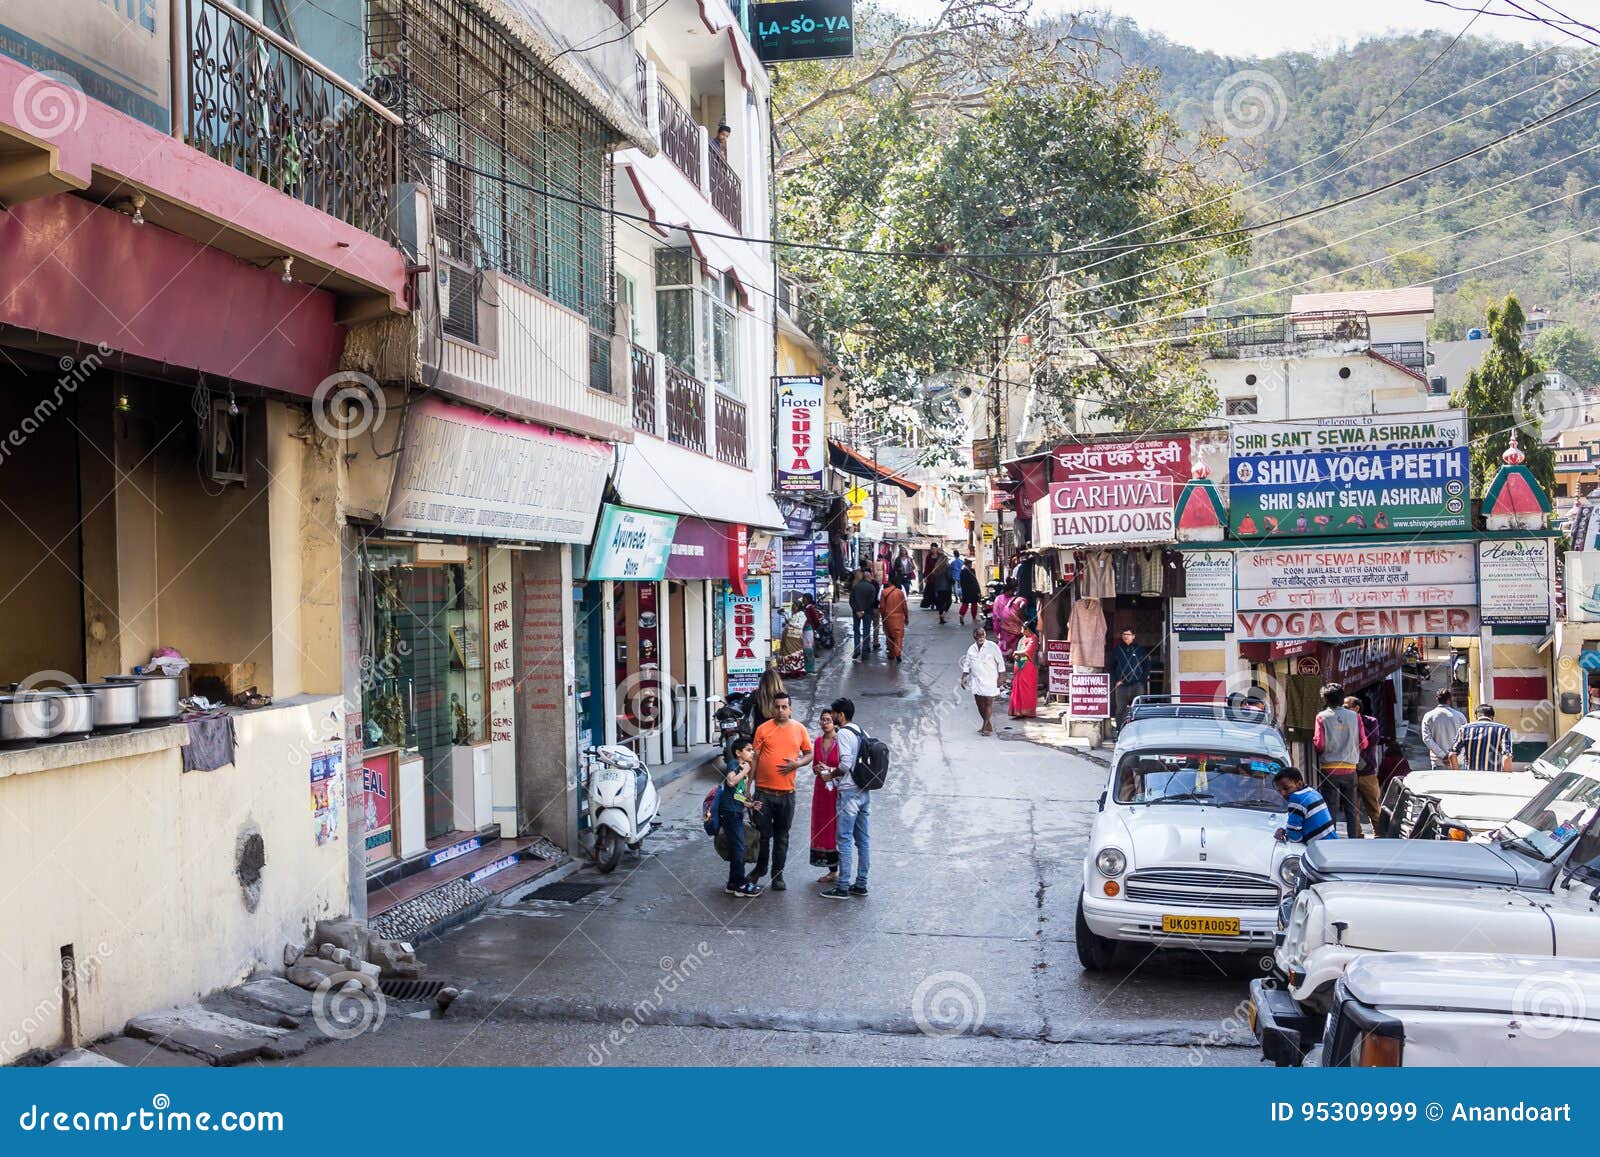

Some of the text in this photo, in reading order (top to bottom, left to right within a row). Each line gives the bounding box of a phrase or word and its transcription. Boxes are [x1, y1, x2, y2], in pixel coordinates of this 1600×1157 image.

[782, 398, 821, 408] Hotel
[791, 408, 811, 470] SURYA
[1236, 434, 1267, 449] SHRI
[1272, 431, 1311, 447] SANT
[1318, 428, 1365, 445] SEWA
[1370, 424, 1436, 442] ASHRAM
[1060, 447, 1103, 469] दर्शन
[1105, 450, 1134, 466] एक
[1137, 441, 1182, 469] मुखी
[1257, 452, 1461, 484] SHIVA YOGA PEETH
[1054, 481, 1169, 510] GARHWAL
[1259, 487, 1442, 511] SHRI SANT SEVA ASHRAM
[1053, 511, 1172, 536] HANDLOOMS
[1393, 518, 1465, 529] www.shivayogapeeth.in
[612, 523, 647, 554] Ayurveda
[623, 558, 639, 576] Store
[1253, 550, 1456, 568] Shri SANT SEWA ASHRAM TRUST
[1284, 567, 1304, 575] ROOM
[1307, 566, 1342, 574] AVAILABLE
[1344, 566, 1362, 574] WITH
[1364, 566, 1387, 574] GANGA
[492, 581, 508, 595] ASK
[493, 600, 508, 614] FOR
[493, 619, 510, 633] REAL
[1237, 608, 1471, 638] YOGA CENTER
[734, 604, 757, 659] SURYA
[493, 639, 509, 653] ONE
[493, 658, 511, 673] FACE
[1072, 676, 1106, 686] GARHWAL
[1072, 687, 1107, 695] HANDLOOMS
[492, 717, 513, 728] GEMS
[492, 731, 512, 742] ZONE
[1169, 917, 1239, 933] UK09TA0052
